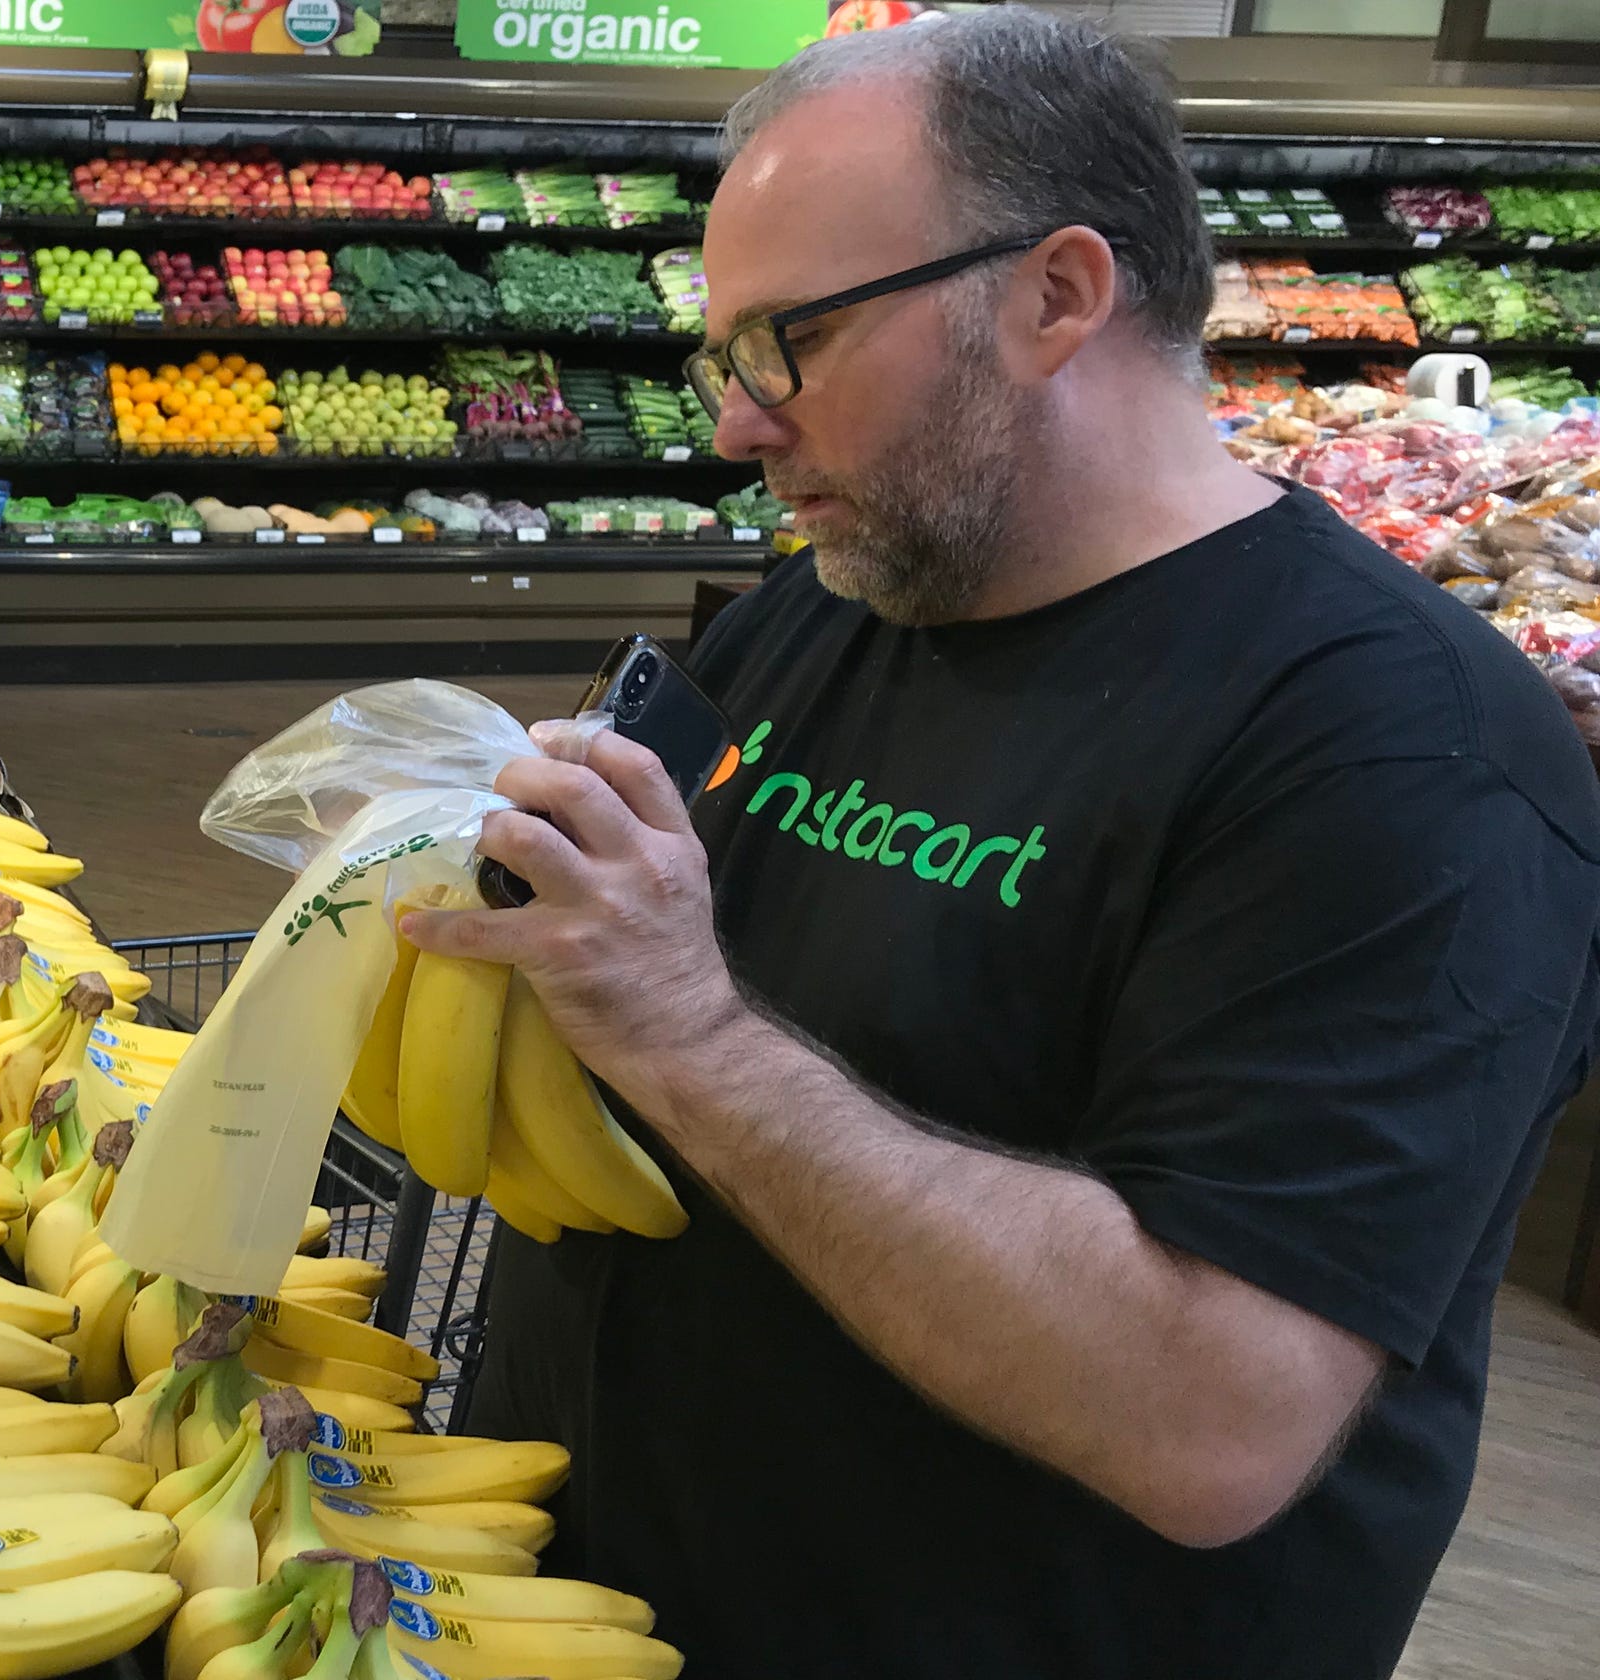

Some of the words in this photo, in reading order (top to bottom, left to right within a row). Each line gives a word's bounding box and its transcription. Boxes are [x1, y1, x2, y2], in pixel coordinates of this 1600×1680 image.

[297, 3, 328, 15] USDA
[493, 6, 702, 60] organic
[327, 862, 358, 894] fruits
